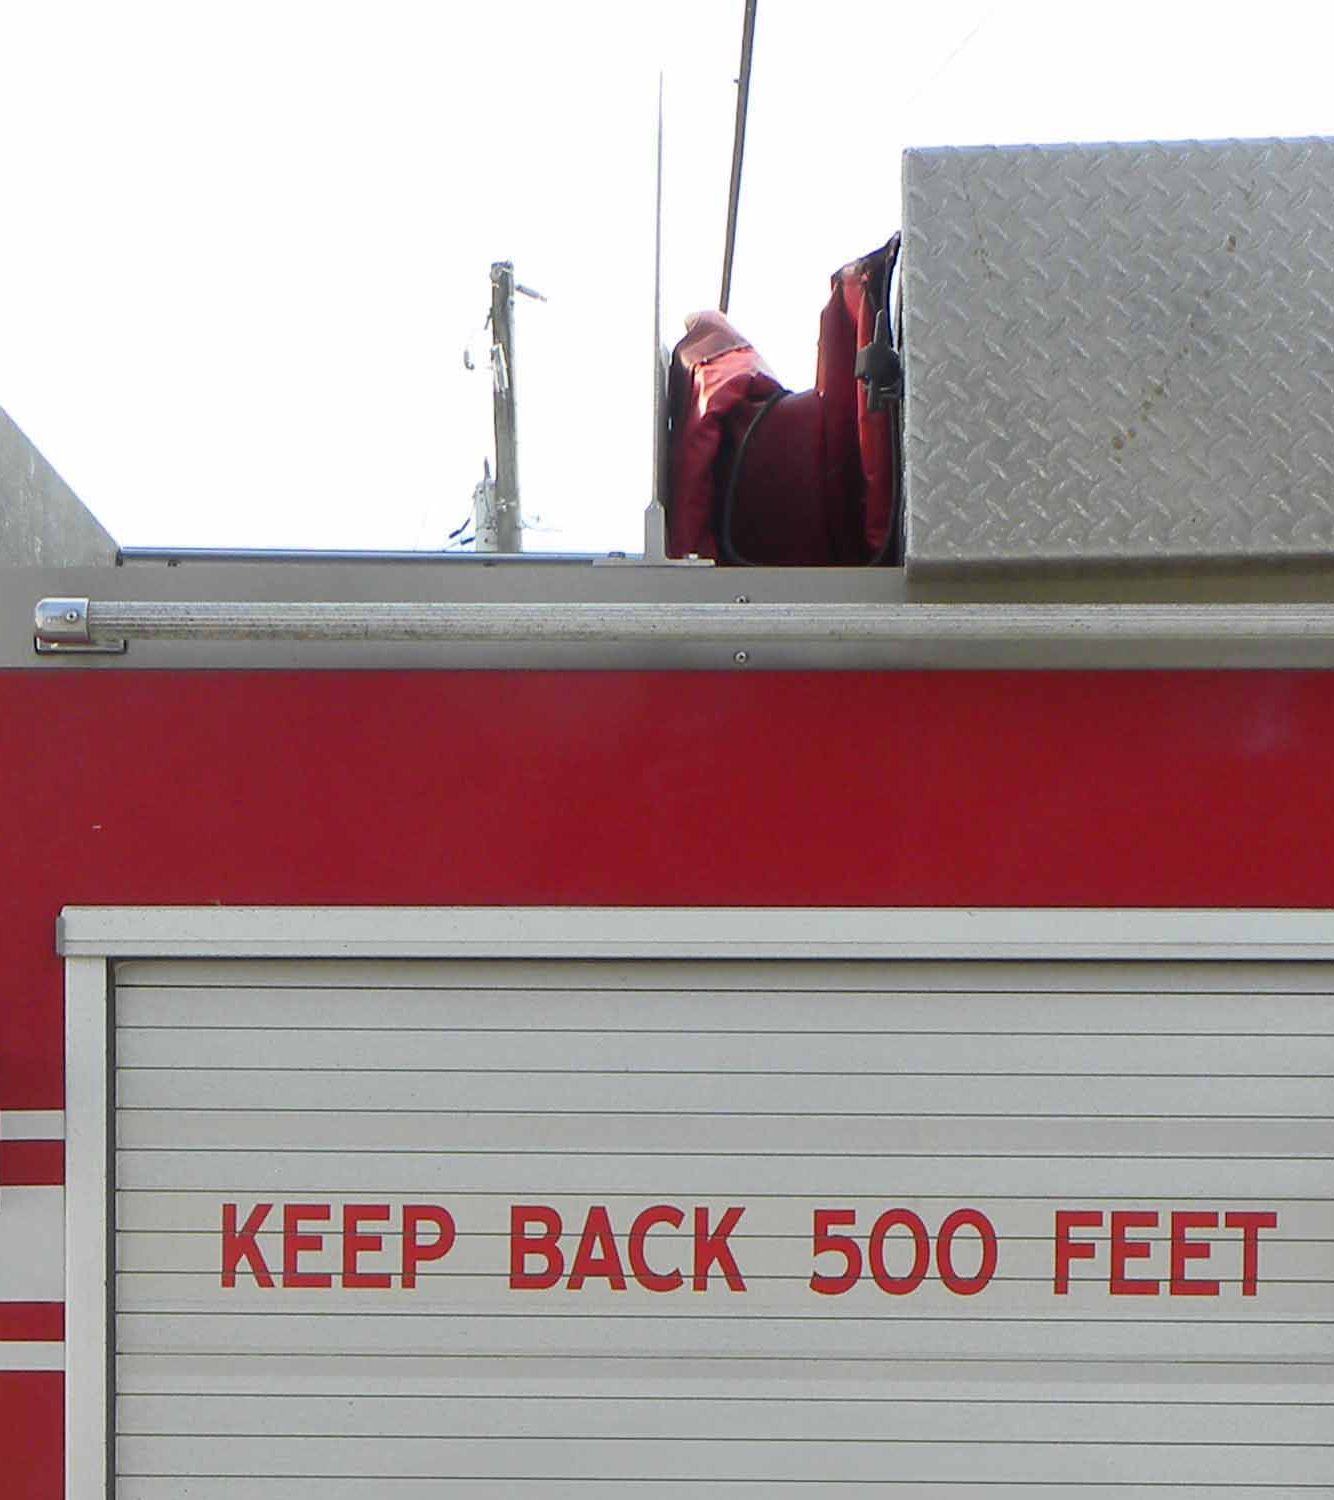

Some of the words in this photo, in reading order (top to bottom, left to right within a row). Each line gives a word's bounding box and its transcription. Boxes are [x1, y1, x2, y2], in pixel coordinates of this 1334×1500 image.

[221, 1203, 456, 1290] KEEP
[508, 1204, 746, 1293] BACK
[809, 1208, 999, 1296] 500
[1053, 1209, 1279, 1297] FEET
